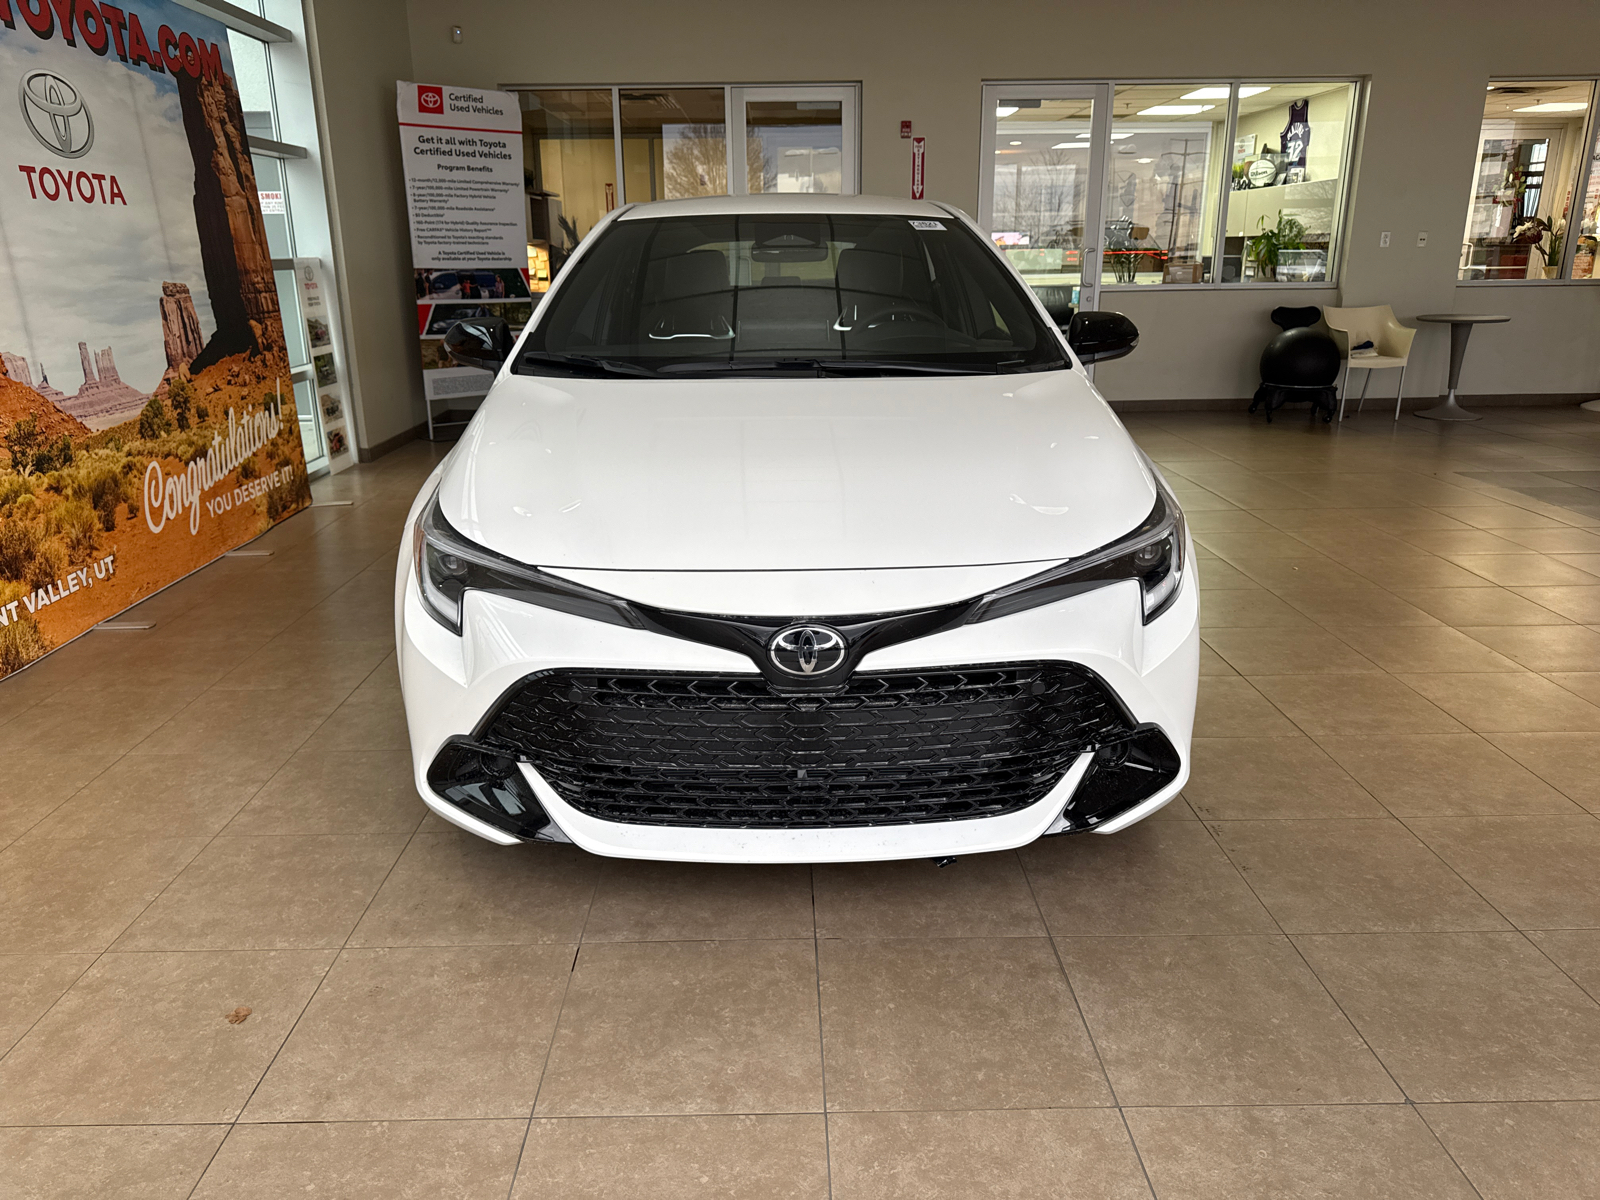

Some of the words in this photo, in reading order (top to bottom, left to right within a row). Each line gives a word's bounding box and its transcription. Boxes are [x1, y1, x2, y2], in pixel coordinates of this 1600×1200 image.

[448, 93, 484, 104] Certified
[450, 104, 470, 113] Used
[472, 105, 504, 115] Vehicles
[418, 135, 435, 145] Get
[436, 136, 443, 144] it
[445, 137, 456, 146] all
[458, 138, 477, 147] with
[479, 139, 506, 149] Toyota
[414, 147, 453, 157] Certified
[455, 149, 476, 158] Used
[478, 150, 512, 160] Vehicles
[437, 164, 465, 172] Program
[18, 164, 127, 206] TOYOTA
[144, 378, 284, 535] Congratulations!
[206, 492, 232, 518] YOU
[234, 470, 280, 506] DESERVE
[281, 465, 294, 484] IT!
[22, 567, 93, 614] VALLEY,
[93, 555, 114, 579] UT
